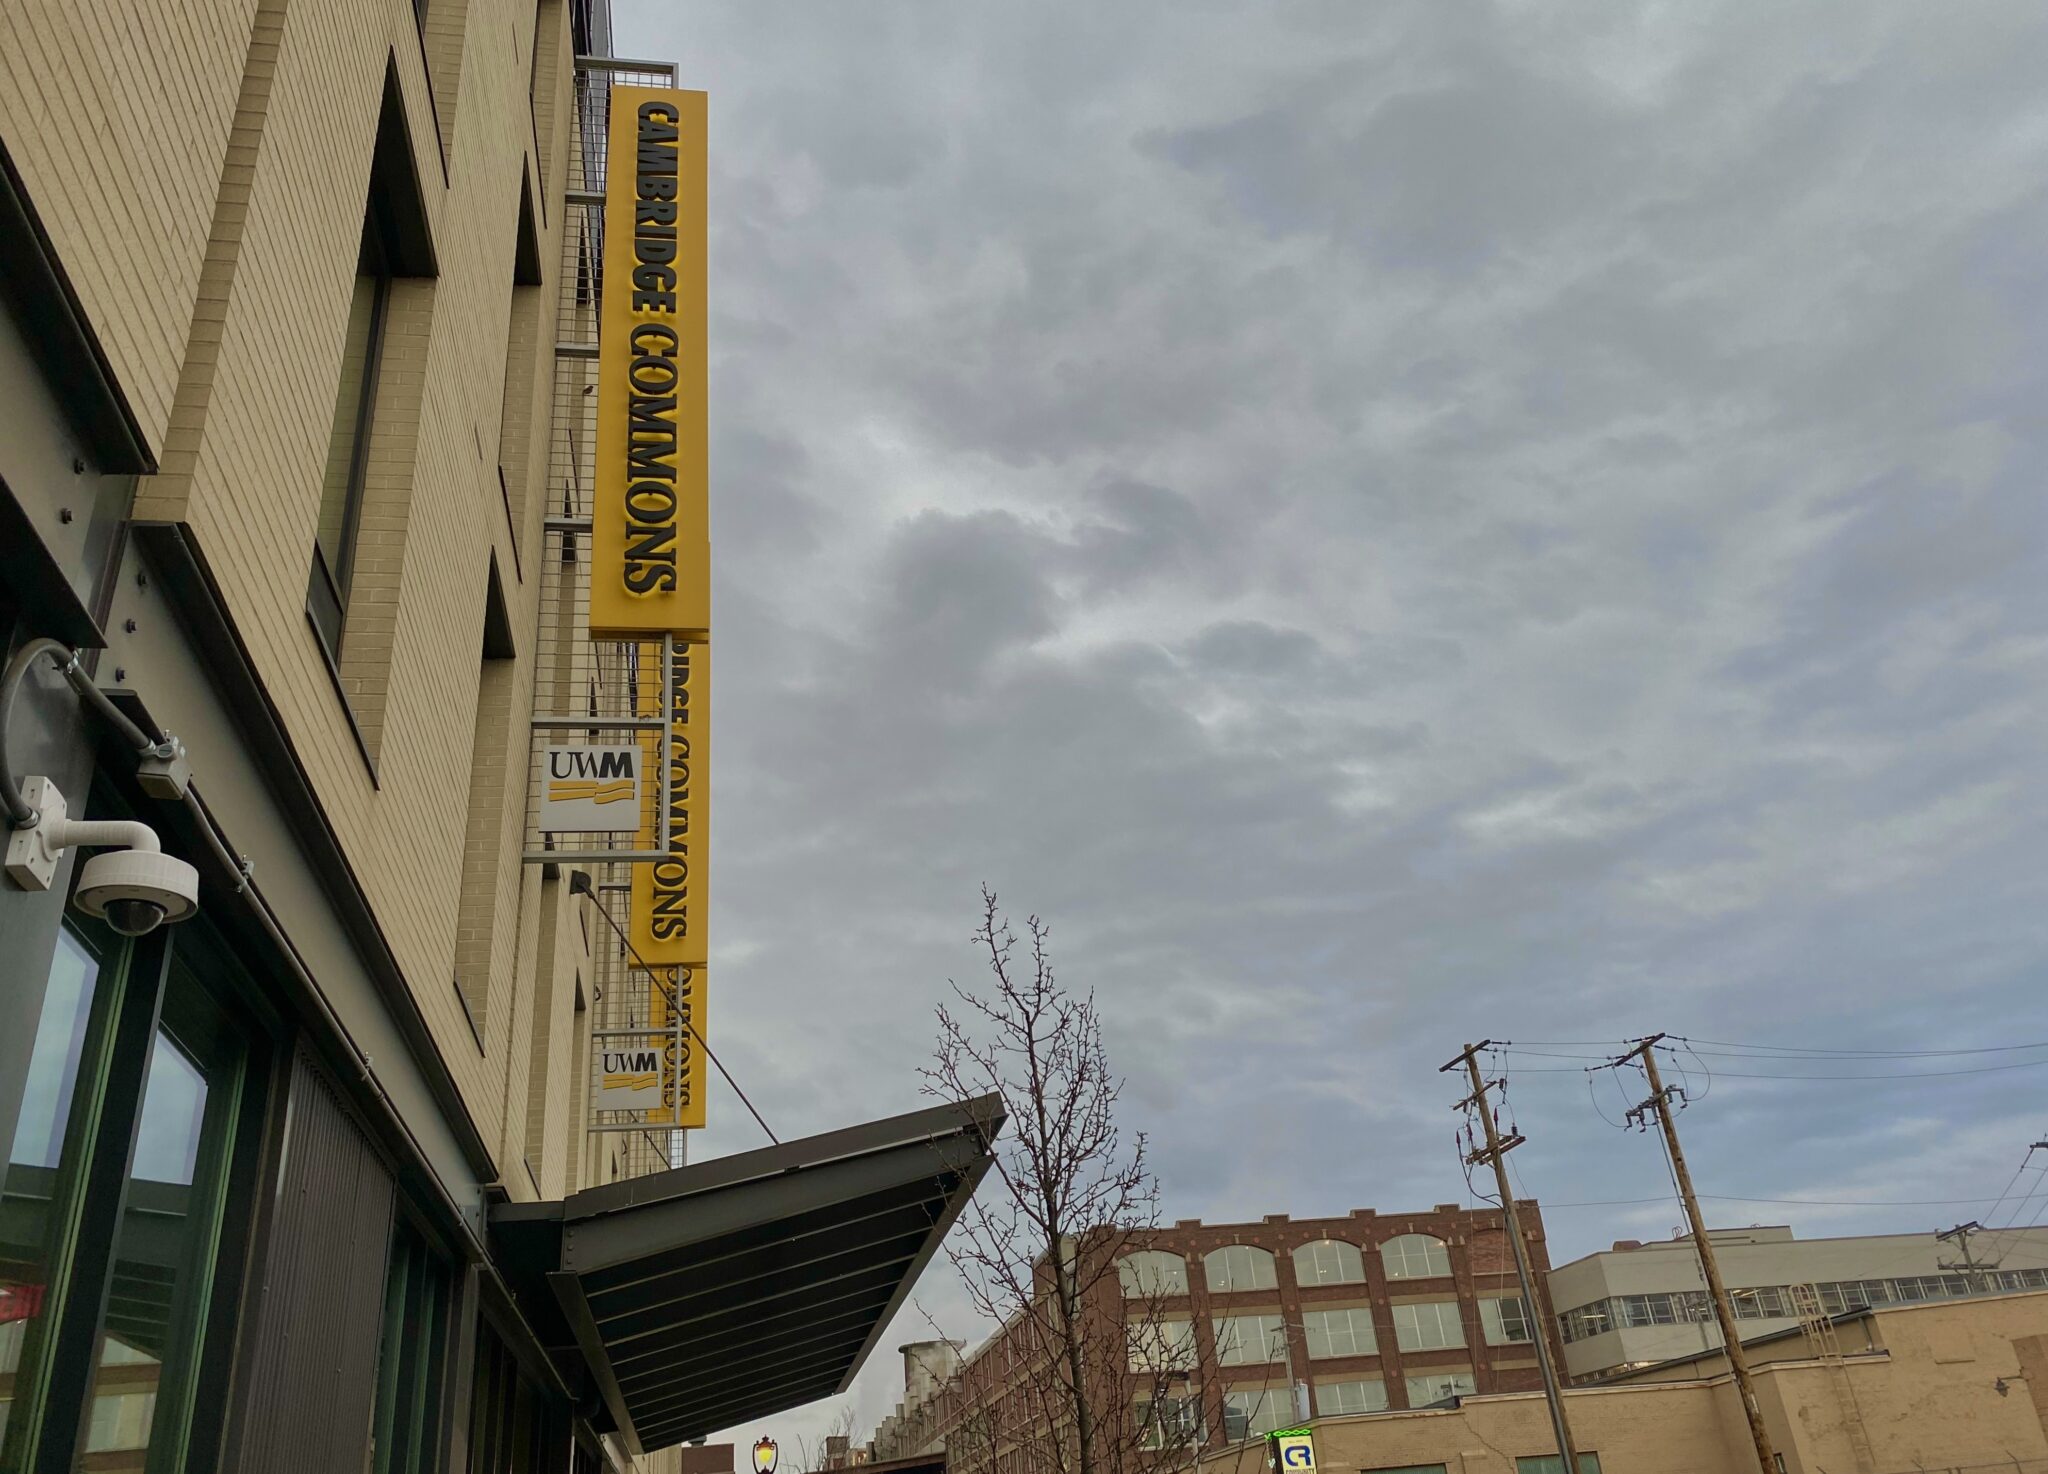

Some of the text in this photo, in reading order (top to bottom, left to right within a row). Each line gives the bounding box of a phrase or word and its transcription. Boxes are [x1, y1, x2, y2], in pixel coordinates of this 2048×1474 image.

[623, 101, 679, 593] CAMBRIDGE COMMONS
[549, 752, 634, 779] UWM
[651, 734, 690, 939] COMMONS
[603, 1053, 657, 1073] UWM
